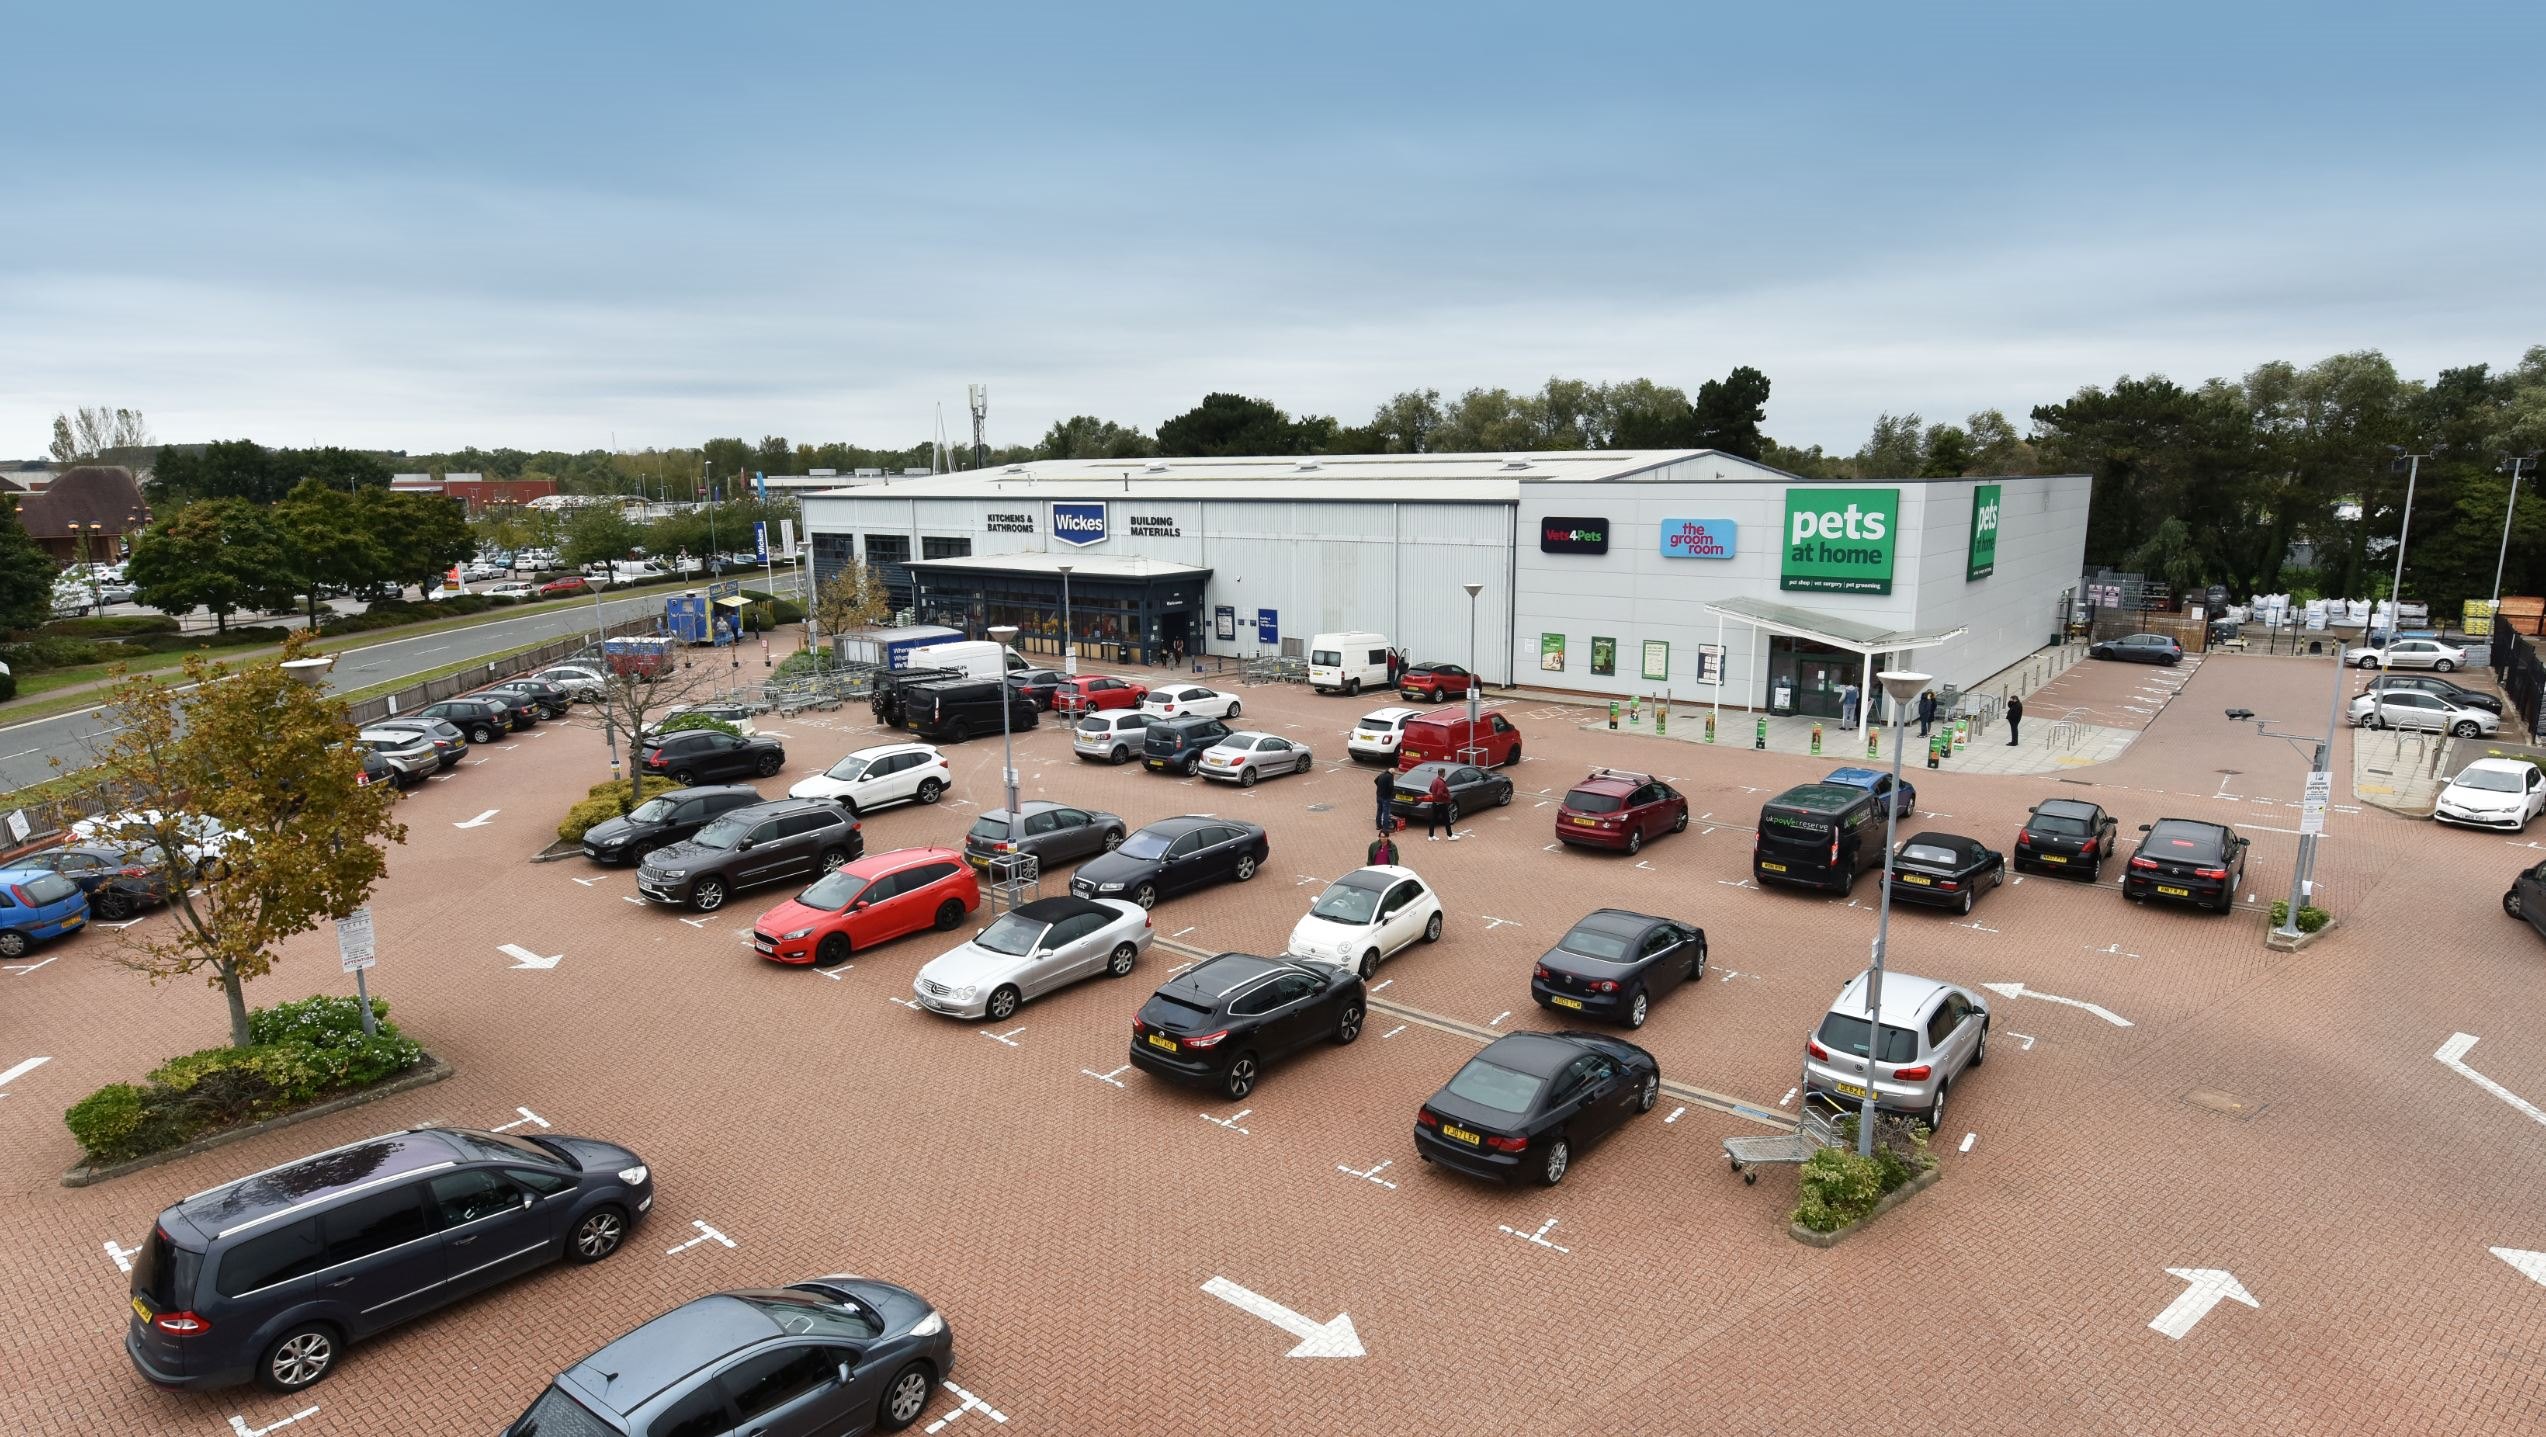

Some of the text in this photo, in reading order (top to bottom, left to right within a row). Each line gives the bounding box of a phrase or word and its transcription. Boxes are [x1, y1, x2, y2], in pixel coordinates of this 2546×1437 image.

[987, 513, 1034, 524] KITCHENS &
[1055, 513, 1104, 532] Wickes
[1130, 515, 1174, 527] BUILDING
[1792, 503, 1886, 545] pets
[1976, 498, 1998, 538] pets
[987, 523, 1034, 534] BATHROOMS
[1130, 526, 1181, 538] MATERIALS
[1682, 522, 1706, 536] the
[1545, 529, 1603, 543] Vets4Pets
[1670, 532, 1714, 548] groom
[1688, 543, 1724, 556] room
[1791, 541, 1882, 564] at home
[344, 955, 374, 966] ATTENTION
[1446, 1125, 1478, 1143] YJ07 LEK
